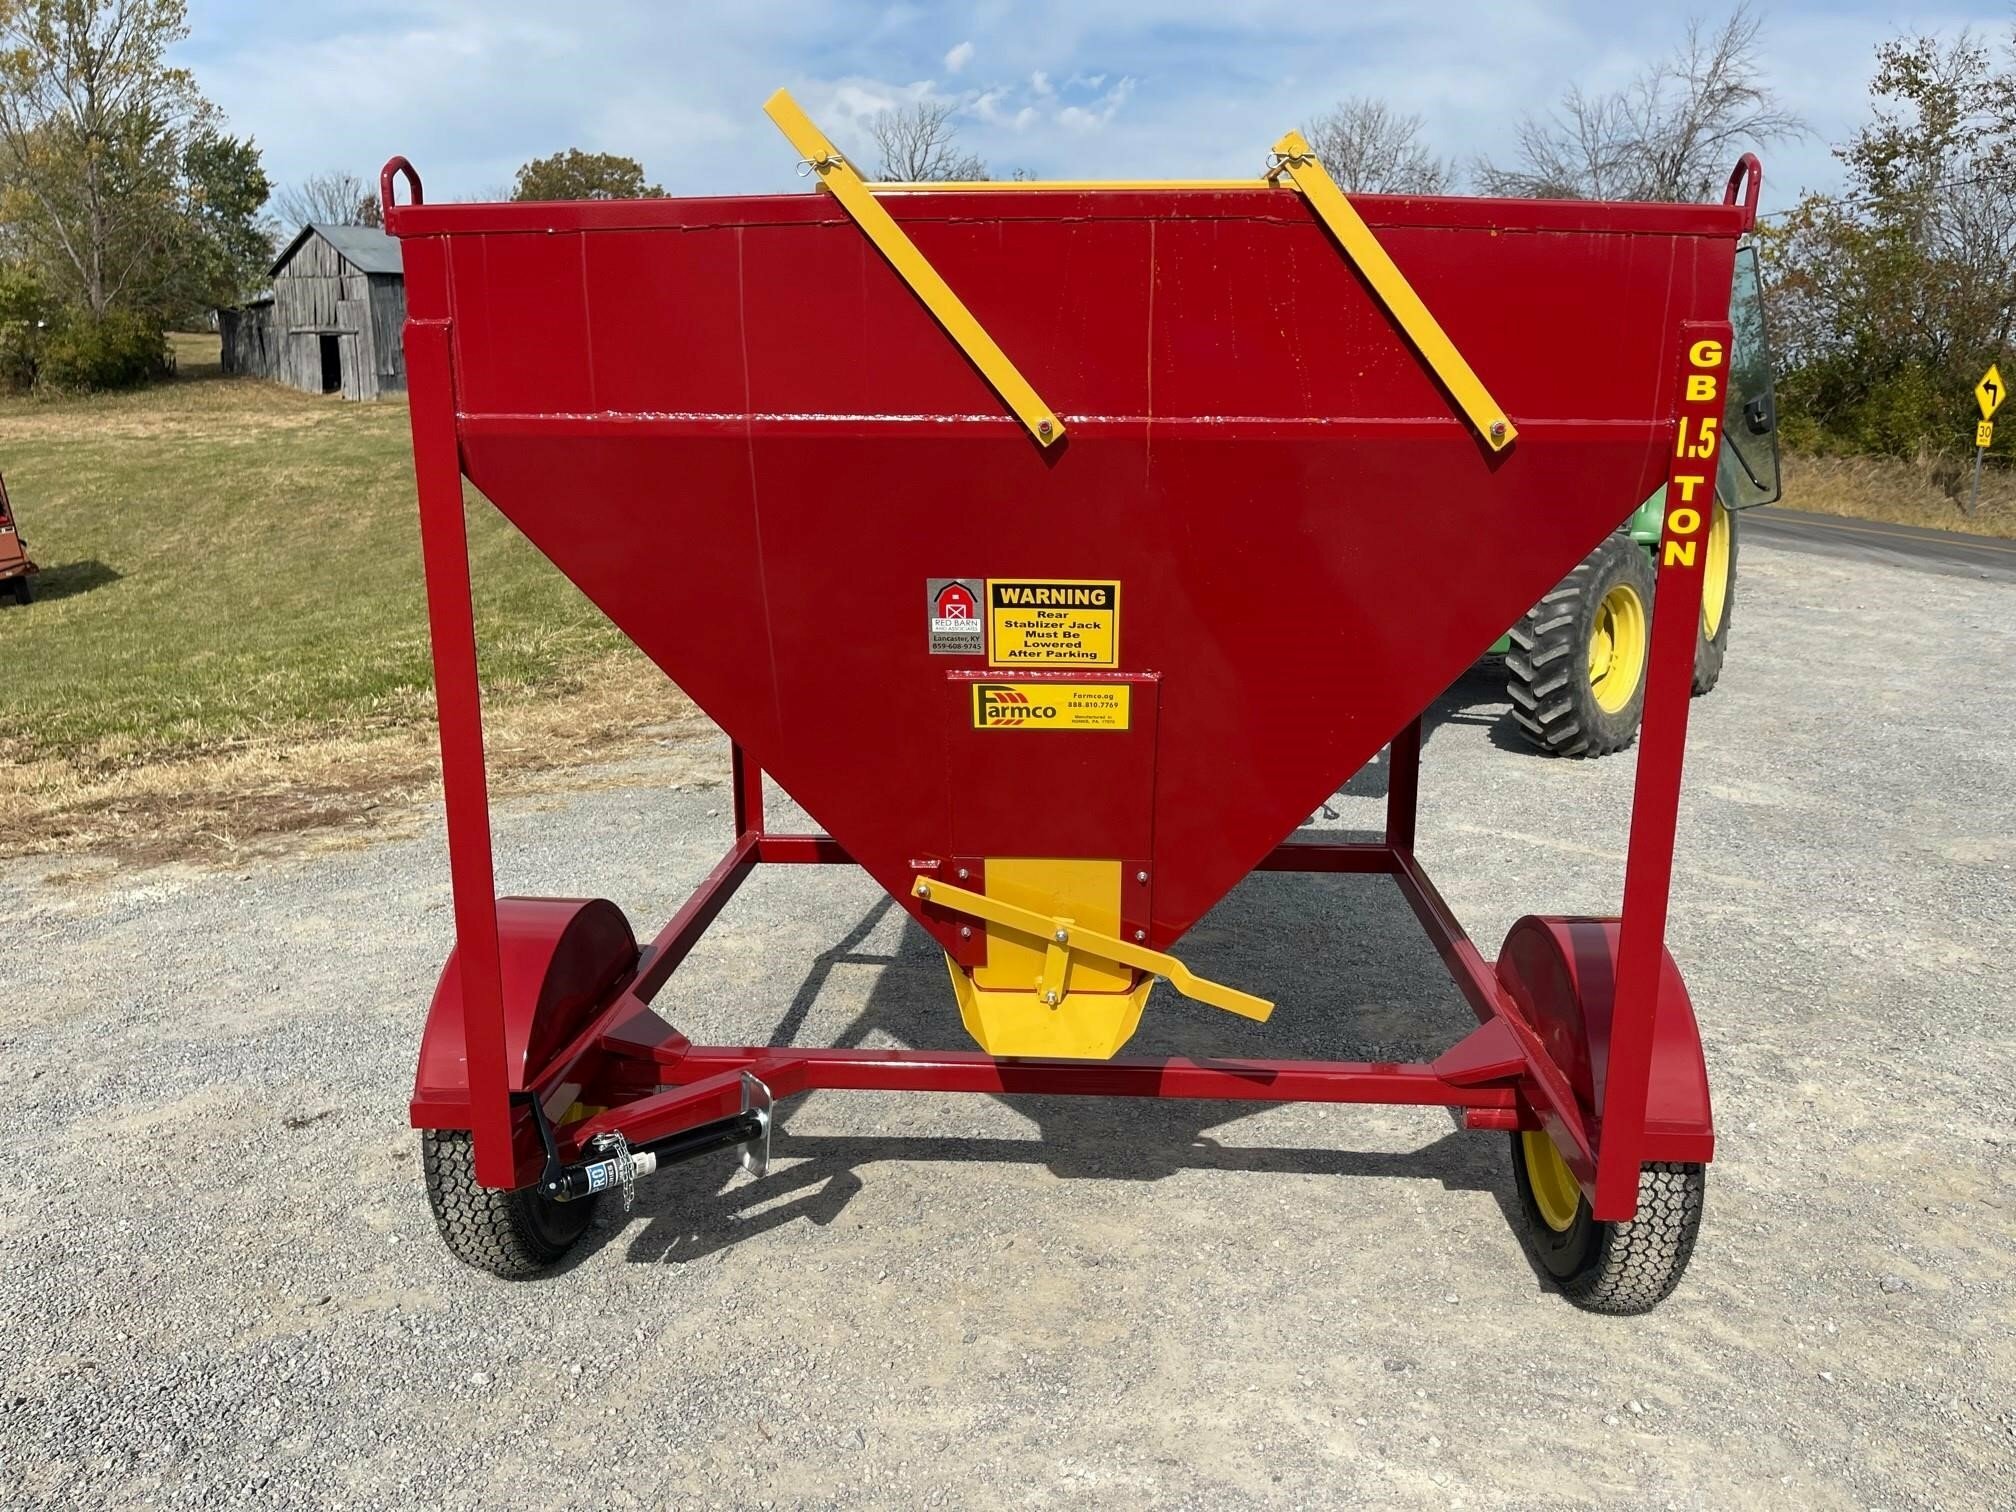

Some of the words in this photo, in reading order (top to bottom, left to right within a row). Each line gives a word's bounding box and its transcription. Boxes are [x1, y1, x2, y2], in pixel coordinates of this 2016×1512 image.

[1979, 425, 1991, 438] 30
[1676, 416, 1718, 459] 1.5
[1664, 475, 1705, 567] TON
[1000, 588, 1106, 605] WARNING
[1037, 611, 1069, 619] Rear
[935, 619, 952, 627] RED
[954, 619, 978, 627] BARN
[1004, 620, 1065, 629] Stablizer
[1068, 621, 1102, 630] Jack
[933, 635, 969, 643] Lancaster,
[1025, 630, 1059, 639] Must
[1062, 631, 1081, 639] Be
[1023, 640, 1082, 649] Lowered
[1008, 649, 1042, 658] After
[1046, 650, 1098, 660] Parking
[1073, 692, 1114, 700] Farmco.ag
[977, 685, 1057, 725] Farmco
[1067, 701, 1119, 709] 888.810.7769
